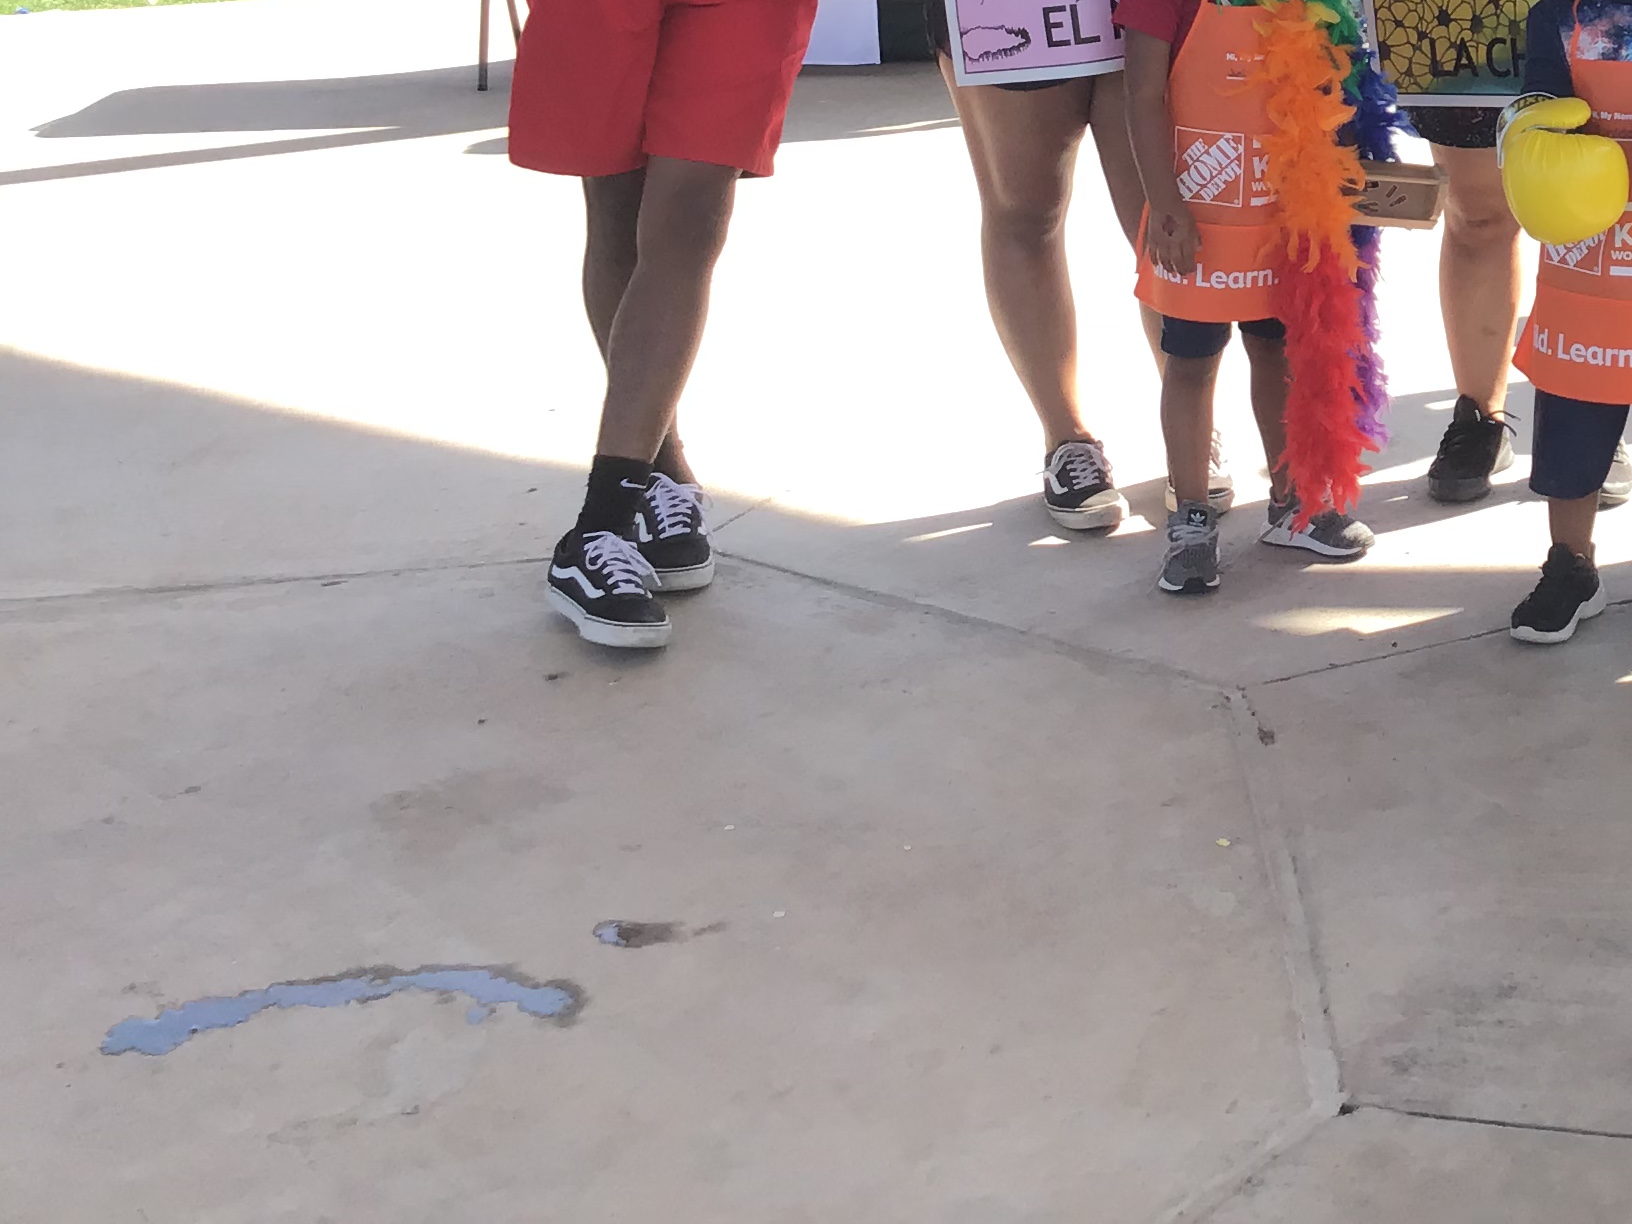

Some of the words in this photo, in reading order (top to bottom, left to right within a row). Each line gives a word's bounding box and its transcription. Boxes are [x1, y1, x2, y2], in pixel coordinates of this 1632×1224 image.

[1042, 3, 1102, 48] EL
[1429, 36, 1479, 78] LA
[1176, 134, 1244, 201] HOME
[1182, 137, 1209, 165] THE
[1199, 160, 1242, 202] DEPOT
[1195, 262, 1280, 289] Learn.
